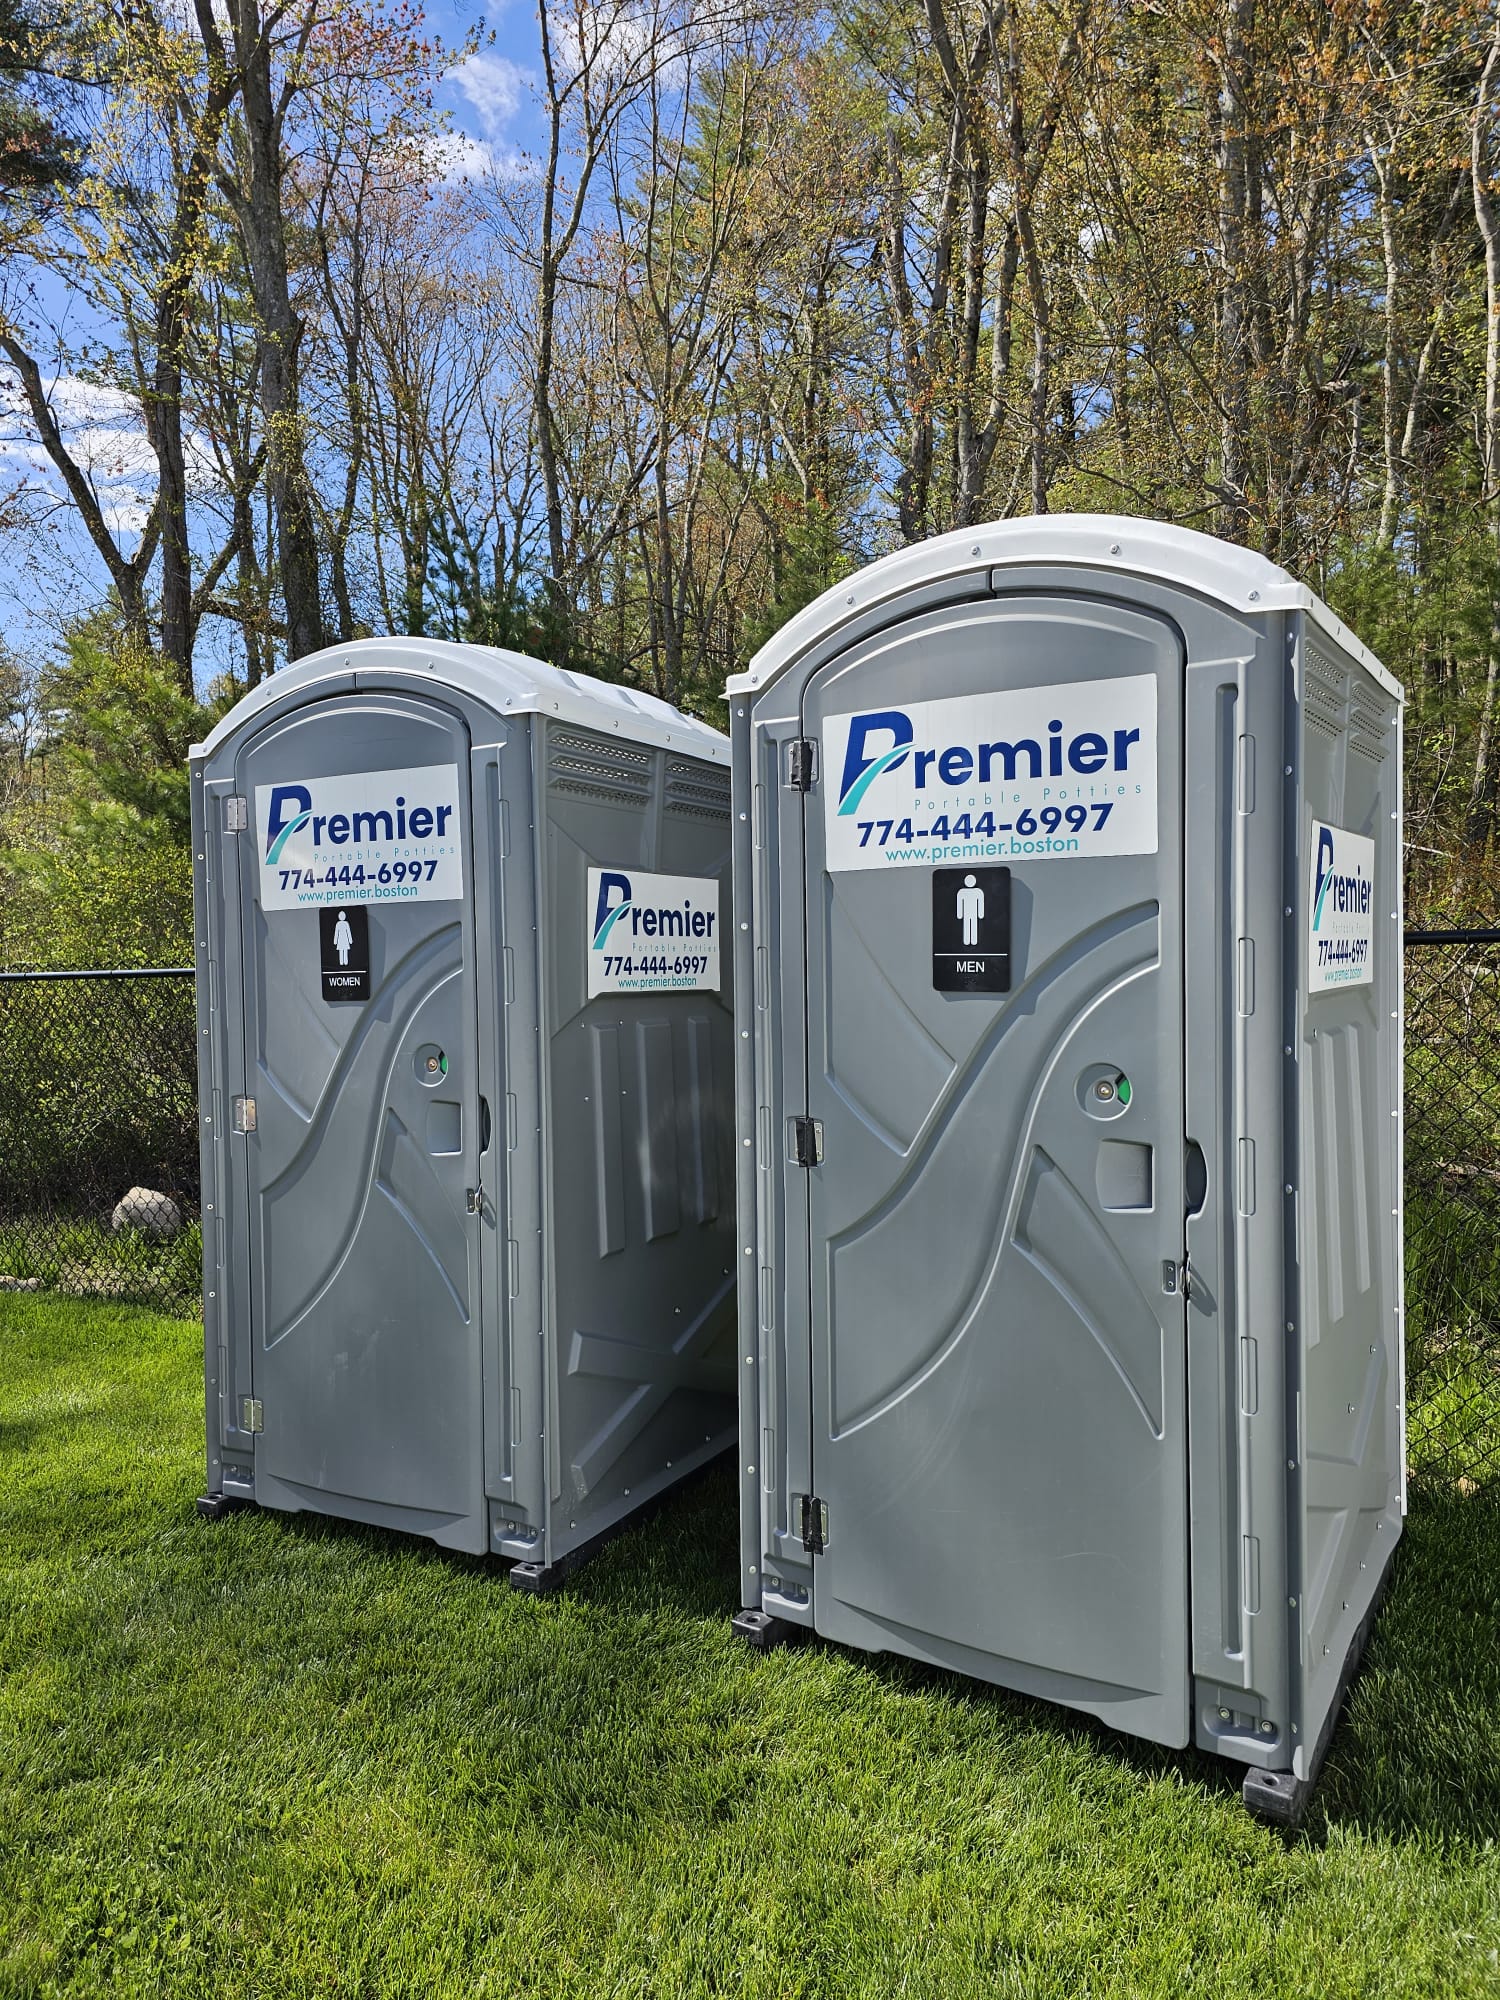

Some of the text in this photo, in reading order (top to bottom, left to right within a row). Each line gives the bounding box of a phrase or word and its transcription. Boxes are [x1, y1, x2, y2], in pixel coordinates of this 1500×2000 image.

[836, 711, 1140, 816] Premier
[914, 783, 1142, 811] Portable Potties
[265, 785, 453, 866] Premier
[857, 802, 1114, 848] 774-444-6997
[314, 845, 456, 863] Portable Potties
[885, 836, 1079, 863] www.premier.boston
[278, 860, 438, 891] 774-444-6997
[1312, 826, 1372, 931] Premier
[297, 884, 418, 903] www.premier.boston
[592, 872, 715, 950] Premier
[603, 956, 708, 976] 774-444-6997
[956, 960, 986, 973] MEN
[1318, 939, 1368, 967] 774-444-6997
[328, 976, 361, 987] WOMEN
[618, 974, 697, 990] www.premier.boston
